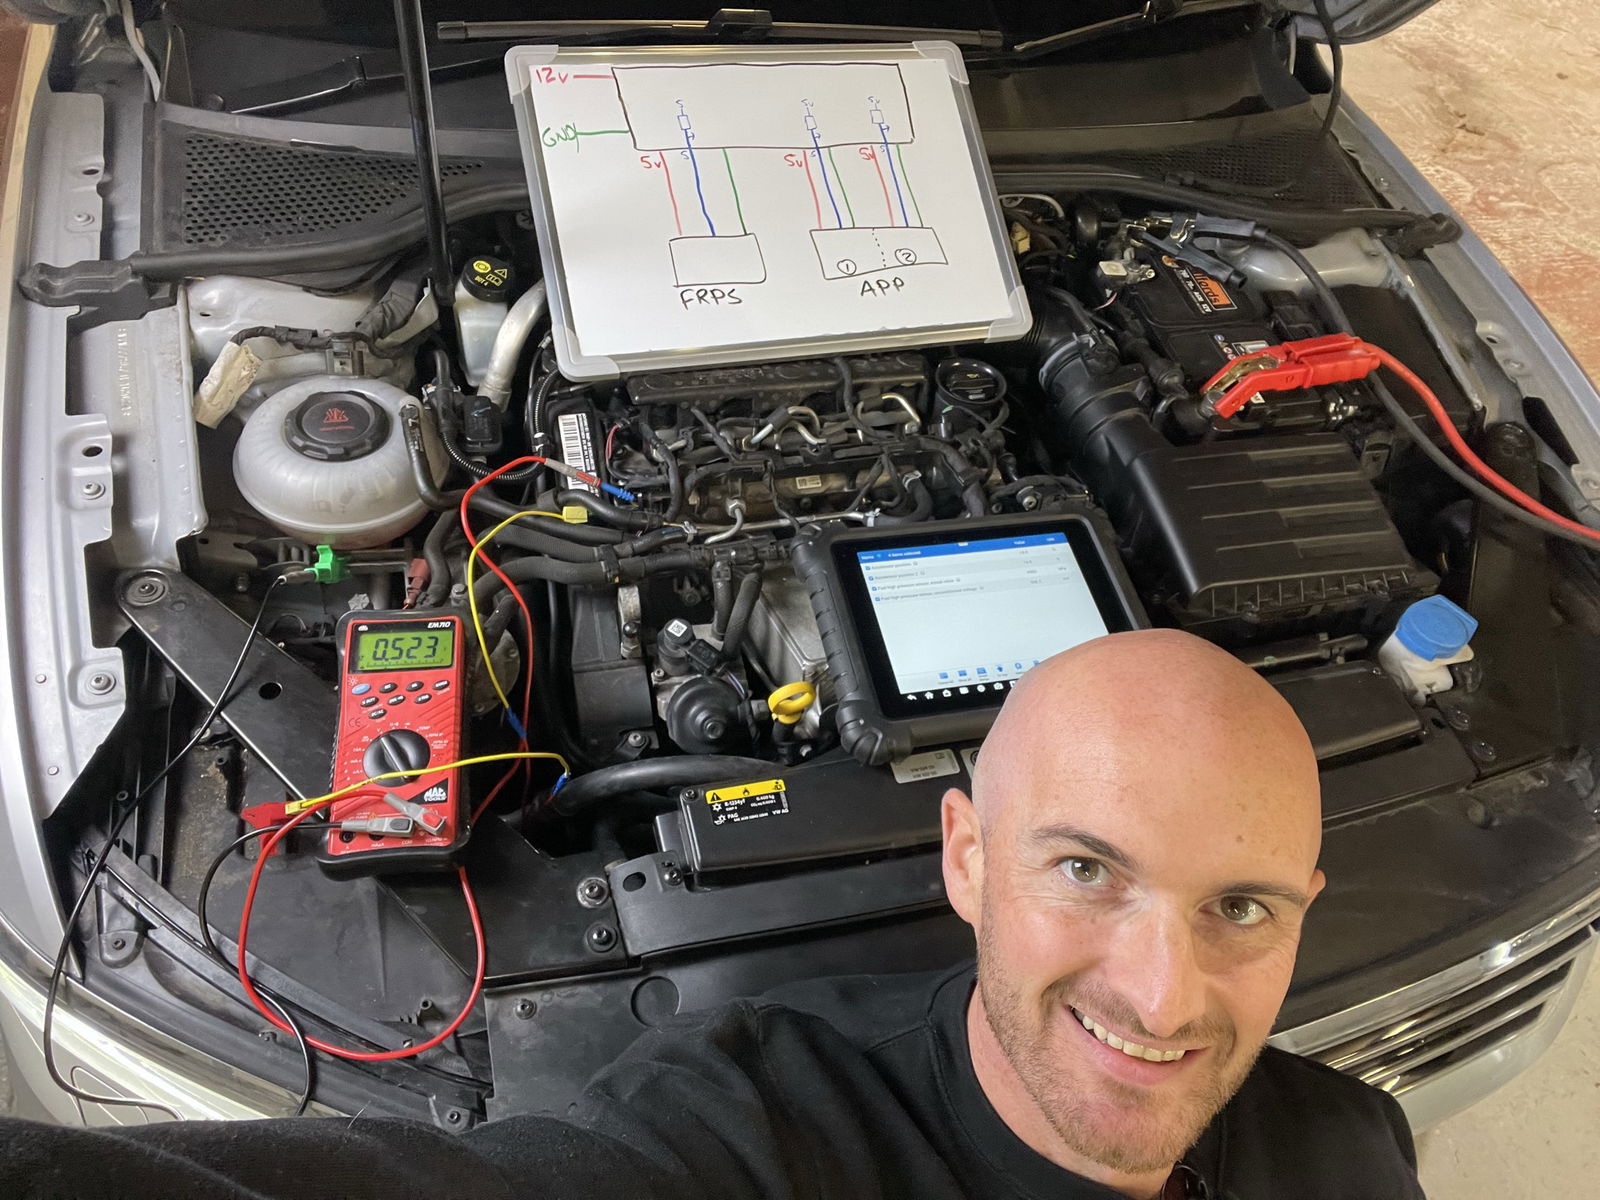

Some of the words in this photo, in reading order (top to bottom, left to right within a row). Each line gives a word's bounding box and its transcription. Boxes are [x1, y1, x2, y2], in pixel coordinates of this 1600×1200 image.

[542, 122, 579, 151] GND
[859, 276, 905, 297] APP
[679, 288, 743, 311] FRPS
[427, 621, 451, 629] EM710
[372, 636, 439, 662] 0.523
[424, 787, 447, 798] MAC
